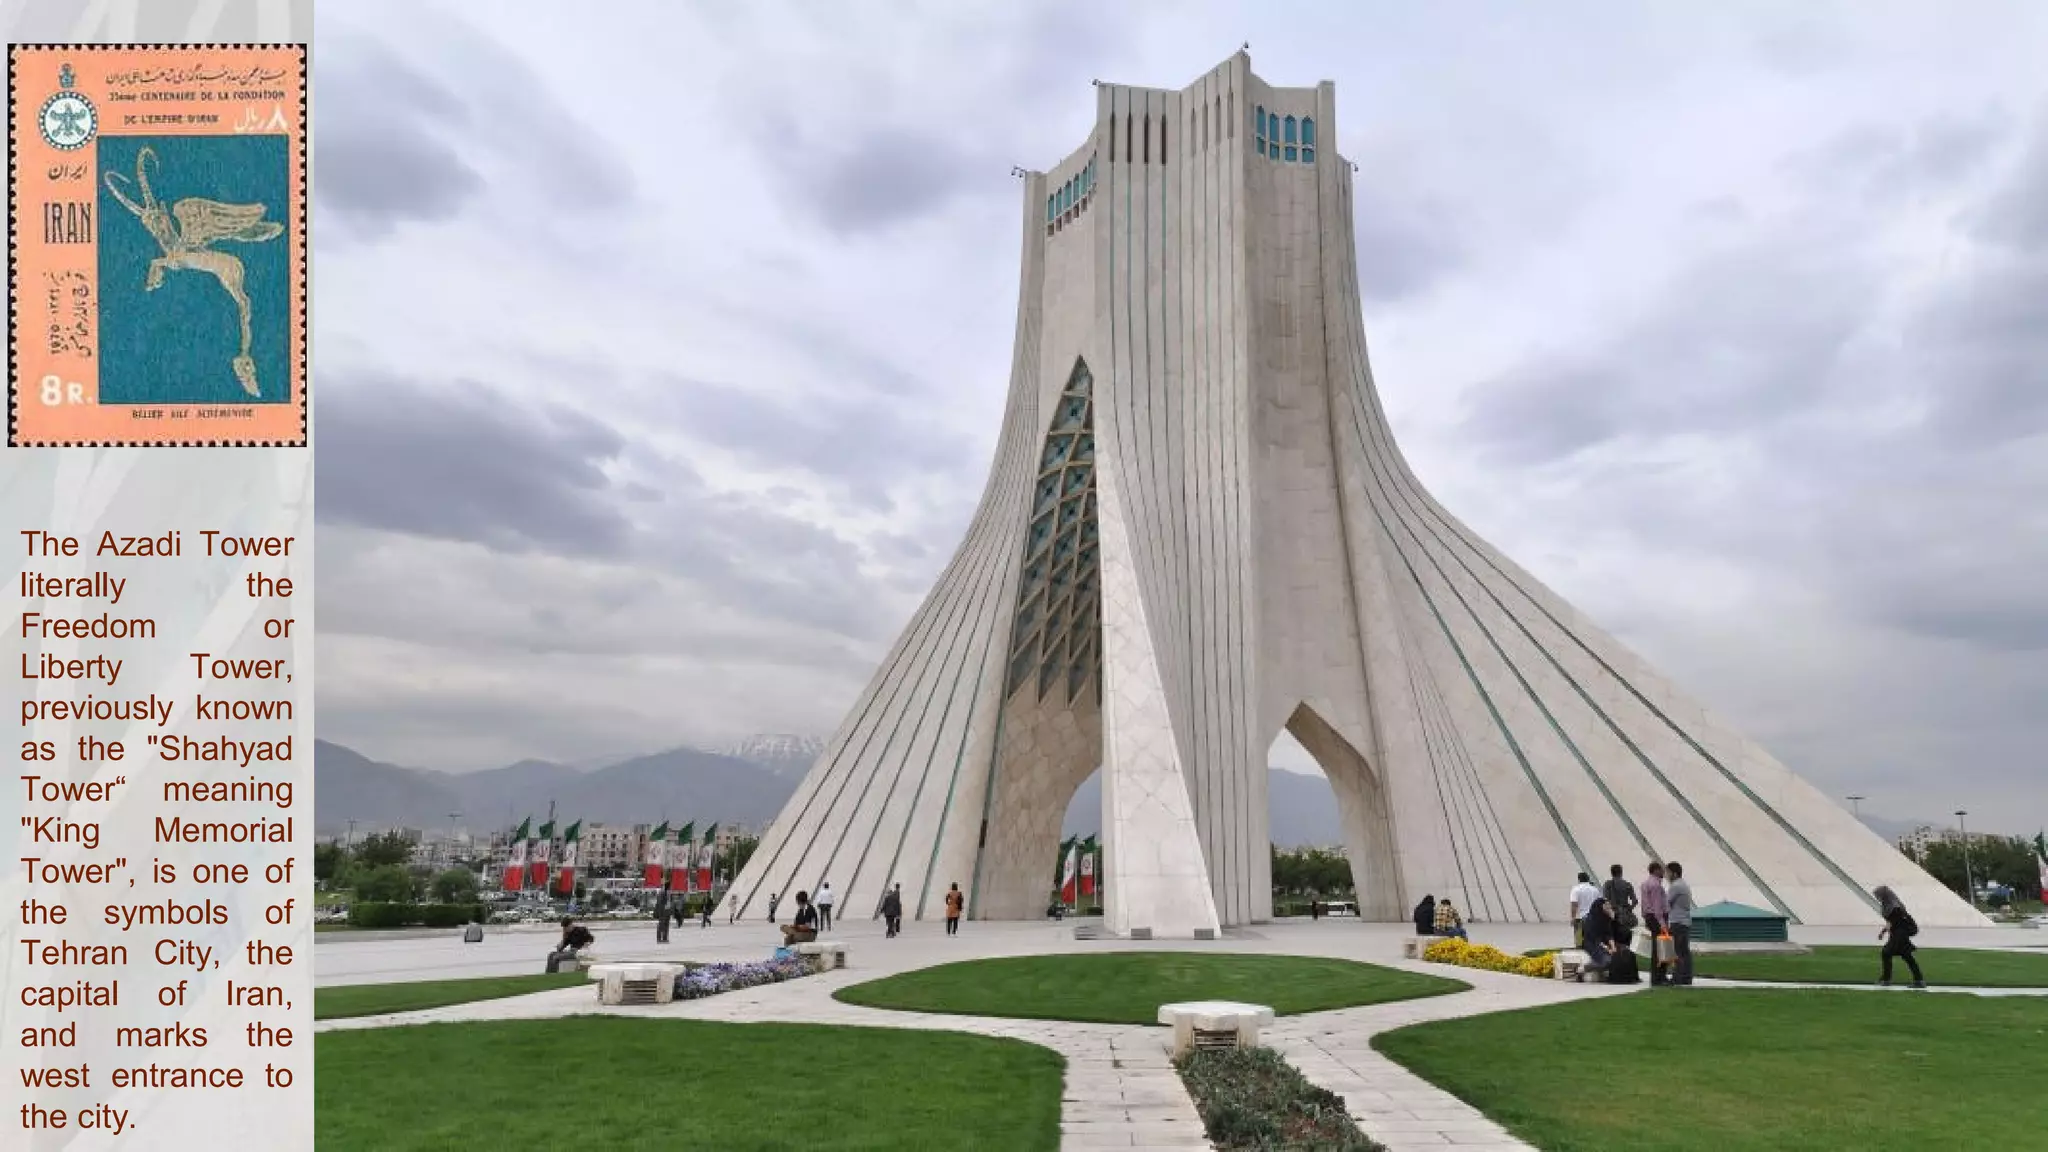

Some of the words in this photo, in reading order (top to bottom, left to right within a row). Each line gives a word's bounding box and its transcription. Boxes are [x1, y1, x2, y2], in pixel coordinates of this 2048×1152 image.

[140, 91, 196, 101] CENTENAIRE
[201, 91, 213, 101] DE
[218, 91, 229, 101] LA
[233, 91, 286, 101] FONDATION
[48, 163, 88, 180] ایران
[44, 202, 92, 244] IRAN
[40, 376, 62, 405] 8
